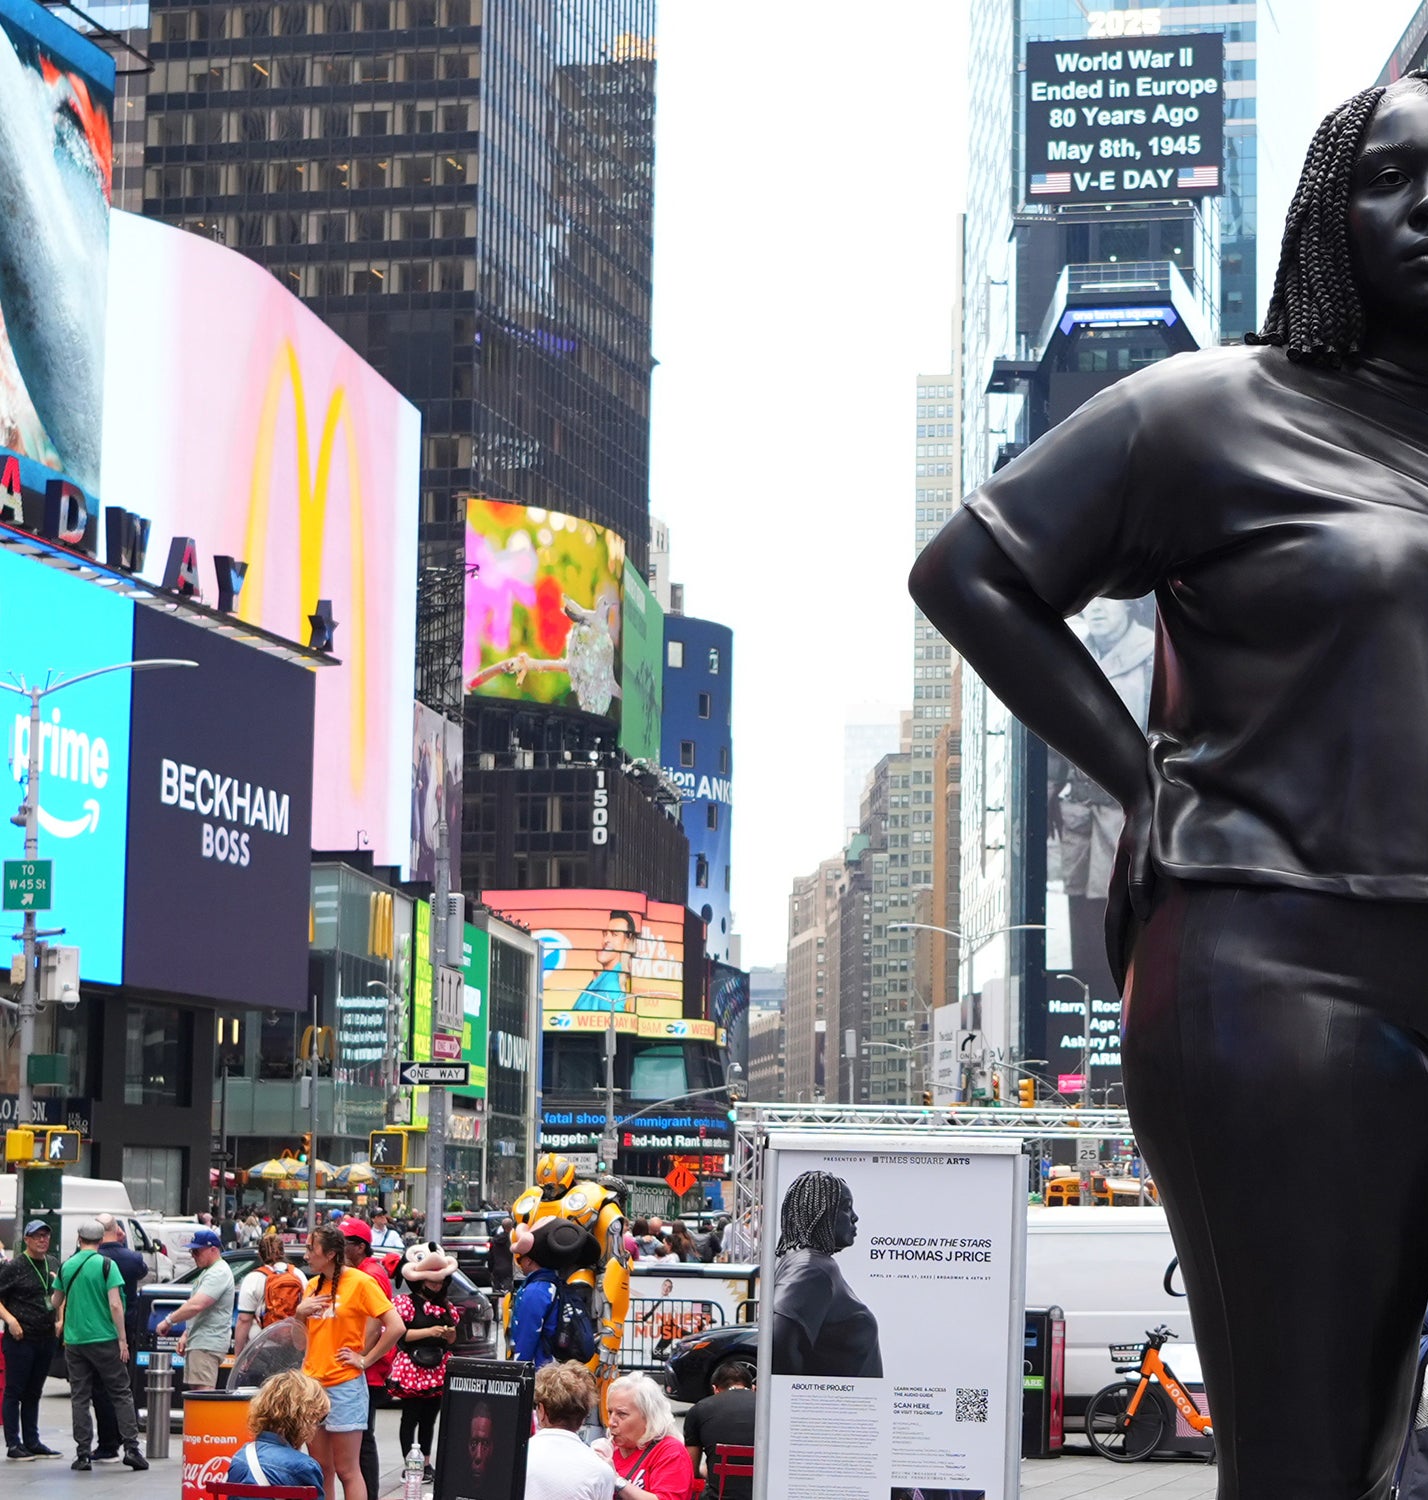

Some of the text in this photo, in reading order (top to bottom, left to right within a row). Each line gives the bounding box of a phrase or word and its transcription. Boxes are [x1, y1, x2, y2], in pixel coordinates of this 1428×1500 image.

[1088, 8, 1162, 37] 2025
[1055, 47, 1193, 73] World War II
[1031, 77, 1217, 101] Ended in Europe
[1050, 104, 1199, 128] 80 Years Ago
[1047, 136, 1201, 163] May 8th, 1945
[1073, 169, 1174, 191] V-E DAY
[13, 708, 109, 789] prime
[161, 758, 290, 835] BECKHAM
[592, 771, 608, 845] 1500
[202, 823, 250, 867] BOSS
[22, 864, 35, 876] TO
[9, 878, 46, 890] W 45 St
[1049, 1000, 1087, 1016] Harry
[1090, 1018, 1116, 1032] Age
[498, 1030, 513, 1069] OLD
[1060, 1035, 1107, 1050] Asbury
[1090, 1053, 1121, 1066] ARM
[410, 1068, 461, 1080] ONE WAY
[544, 1113, 572, 1124] fatal
[880, 1156, 907, 1164] TIMES
[910, 1156, 944, 1165] SQUARE
[1079, 1150, 1097, 1161] 25
[870, 1236, 992, 1249] GROUNDED IN THE STARS
[870, 1249, 992, 1264] BY THOMAS J PRICE
[635, 1311, 712, 1326] FNNIEST
[450, 1376, 486, 1394] MIDNIGHT
[791, 1383, 813, 1391] ABOUT
[826, 1384, 855, 1392] PROJECT
[1165, 1381, 1192, 1415] JOCO
[203, 1434, 238, 1444] Cream
